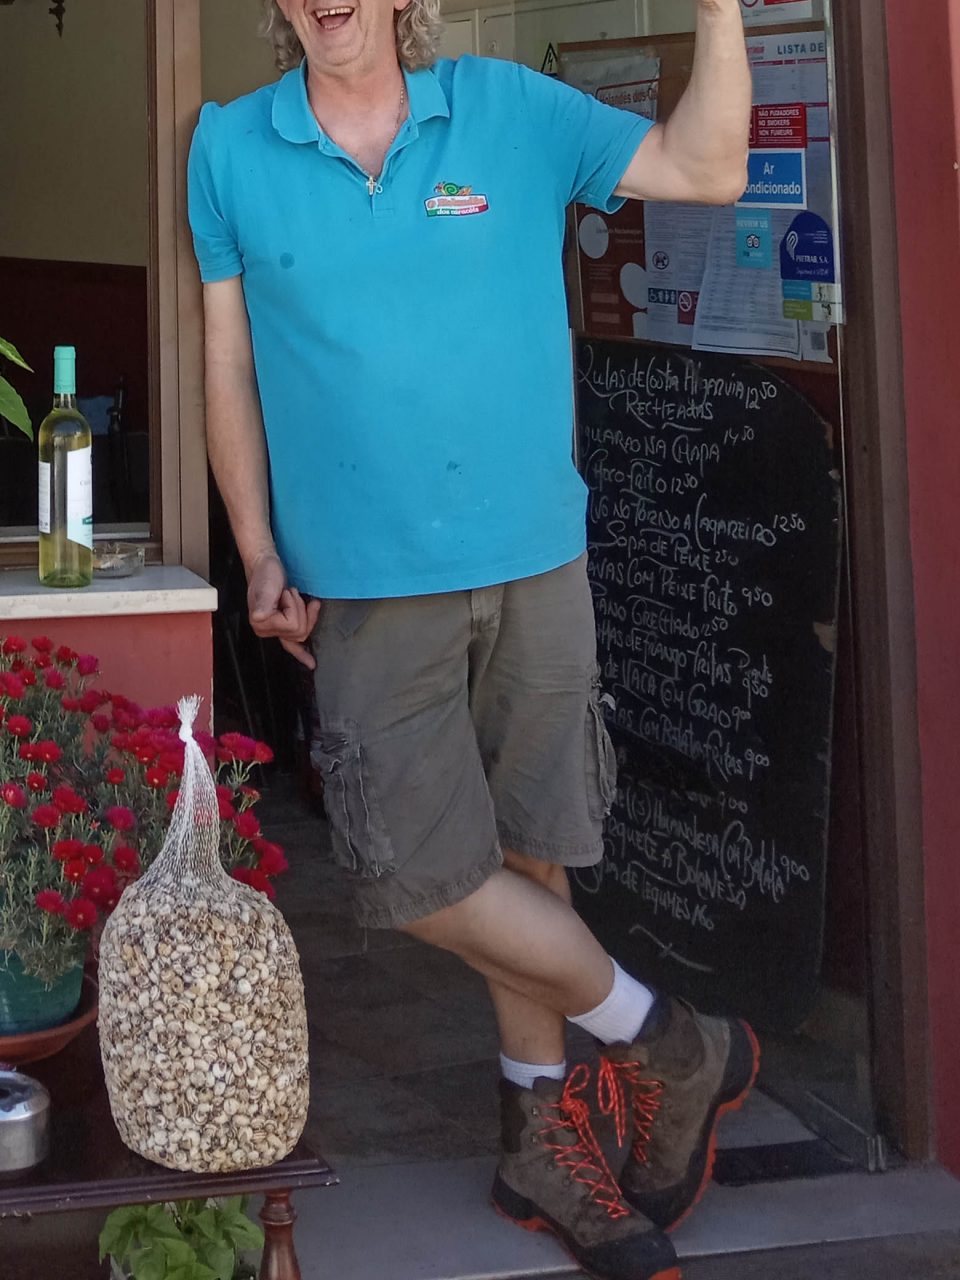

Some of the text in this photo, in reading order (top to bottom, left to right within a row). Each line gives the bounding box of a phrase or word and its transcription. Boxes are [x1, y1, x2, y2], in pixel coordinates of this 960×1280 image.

[777, 43, 807, 55] LISTA
[809, 42, 824, 52] DE
[758, 108, 800, 117] NÃO FUMADORES
[763, 161, 775, 175] Ar
[744, 181, 801, 195] ondicionado
